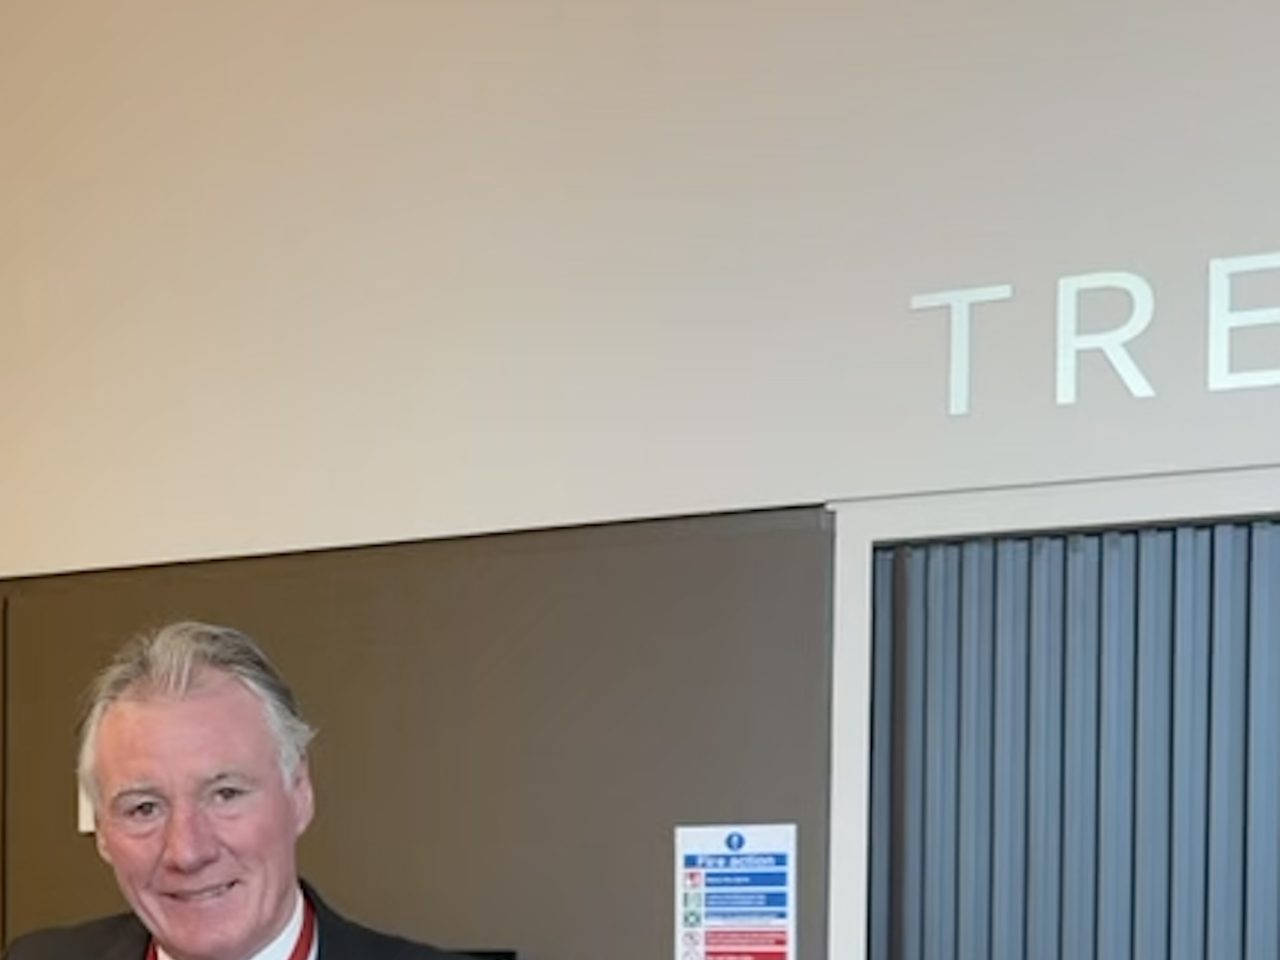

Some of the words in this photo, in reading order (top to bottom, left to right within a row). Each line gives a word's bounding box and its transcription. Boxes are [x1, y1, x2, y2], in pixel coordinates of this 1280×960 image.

[910, 251, 1280, 415] TRE
[697, 855, 726, 868] Fire
[730, 855, 775, 867] action
